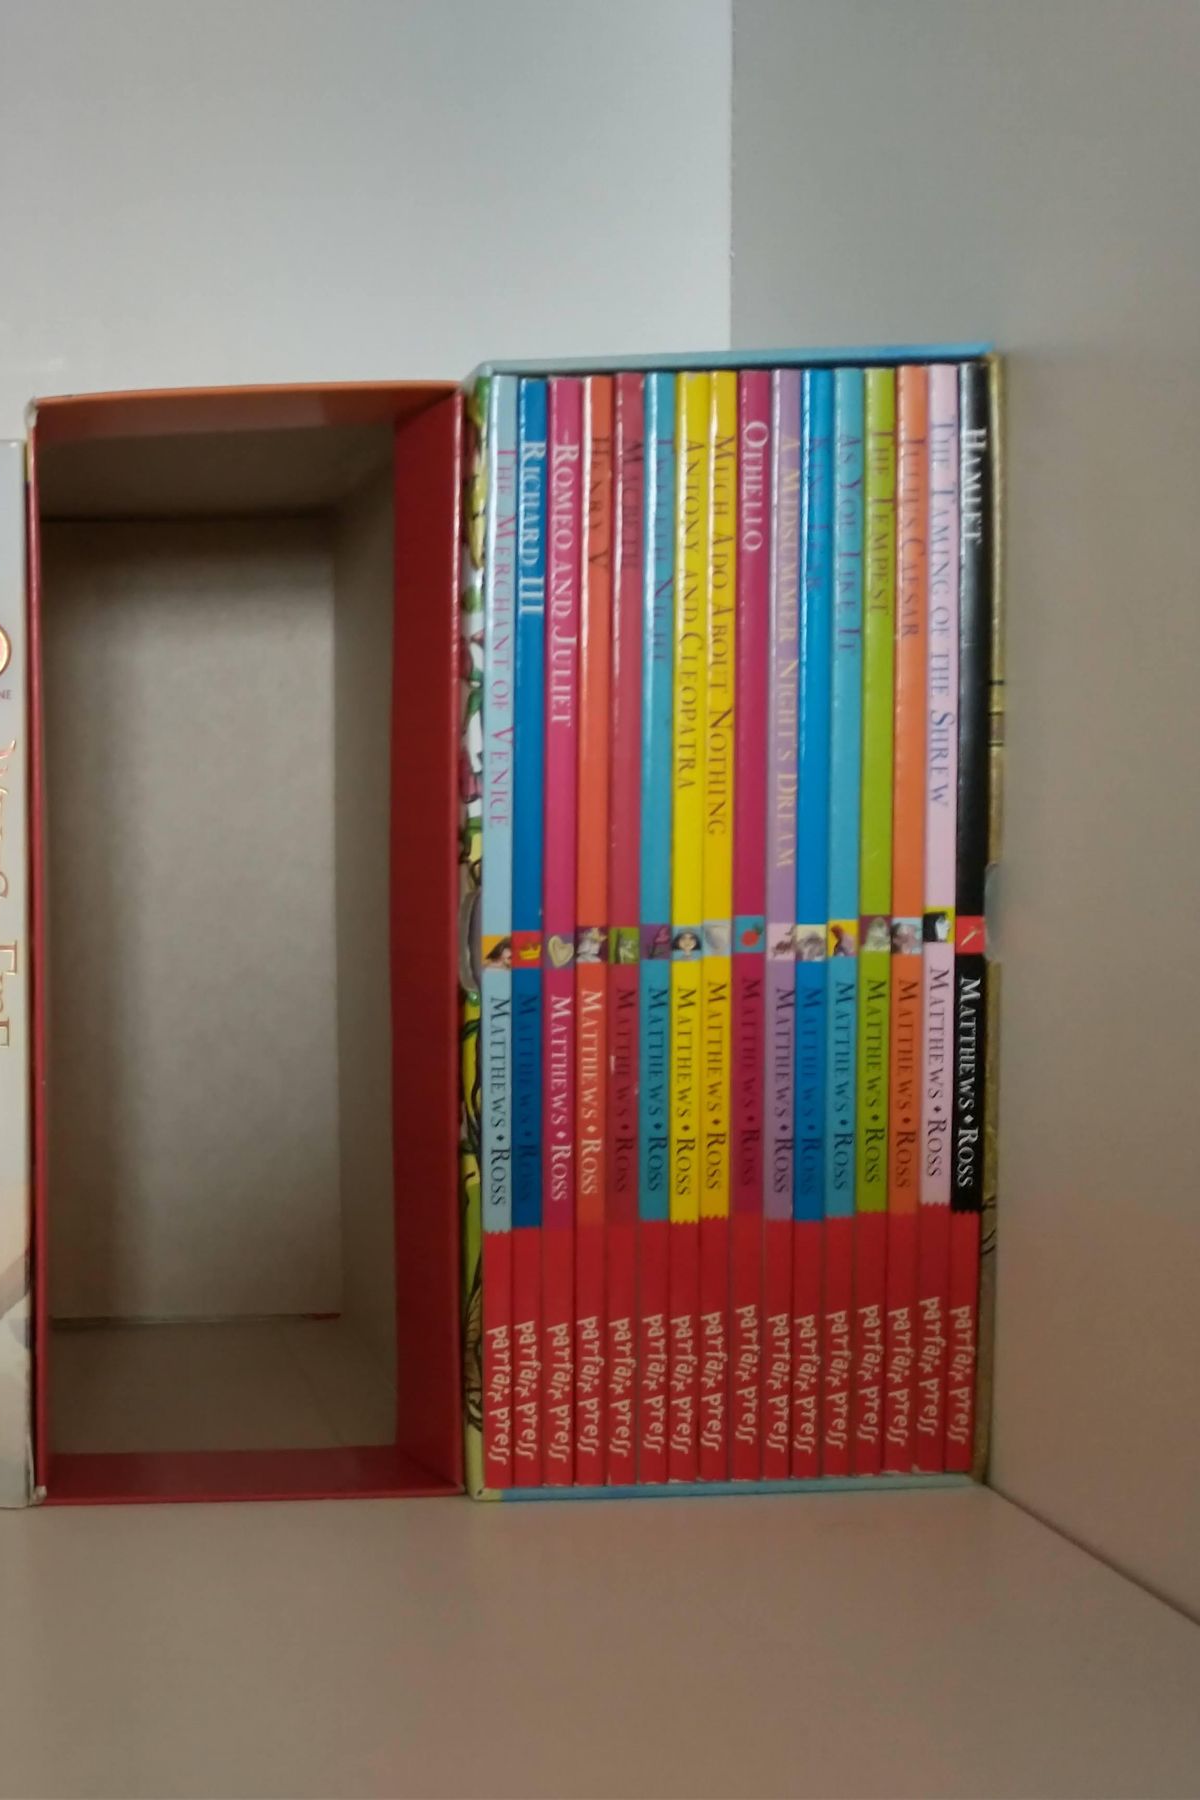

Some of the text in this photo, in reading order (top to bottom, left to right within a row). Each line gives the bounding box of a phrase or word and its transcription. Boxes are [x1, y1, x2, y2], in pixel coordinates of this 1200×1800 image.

[520, 441, 546, 616] RICHARD III
[742, 421, 769, 551] OTHELLO
[870, 498, 894, 616] TEMPEST
[929, 480, 956, 595] TAMING
[961, 428, 986, 544] HAMLET
[490, 448, 517, 828] THE MERCHANT OF VENICE
[551, 444, 579, 726] ROMEO AND JULIET
[678, 440, 704, 789] ANTONY AND CLEOPATRA
[708, 434, 734, 835] MUCH ADO ABOUT NOTHING
[777, 436, 800, 868] A MIDSUMMER NIGHT'S DREAM
[901, 537, 925, 639] CAESAR
[929, 606, 951, 639] OF
[929, 651, 950, 697] THE
[929, 710, 955, 807] SHREW
[490, 997, 510, 1205] MATTHEWS ROSS
[550, 995, 571, 1200] MATTHEWS ROSS
[580, 990, 602, 1194] MATTHEWS ROSS
[676, 987, 696, 1195] MATTHEWS ROSS
[706, 981, 728, 1189] MATTHEWS ROSS
[864, 980, 887, 1183] MATTHEWS ROSS
[927, 968, 949, 1177] MATTHEWS ROSS
[958, 978, 980, 1187] MATTHEWS ROSS
[486, 1326, 512, 1465] parfait press
[547, 1323, 573, 1462] parfait press
[886, 1308, 914, 1446] parfait press
[917, 1296, 946, 1436] parfait press
[948, 1306, 976, 1444] parfait press
